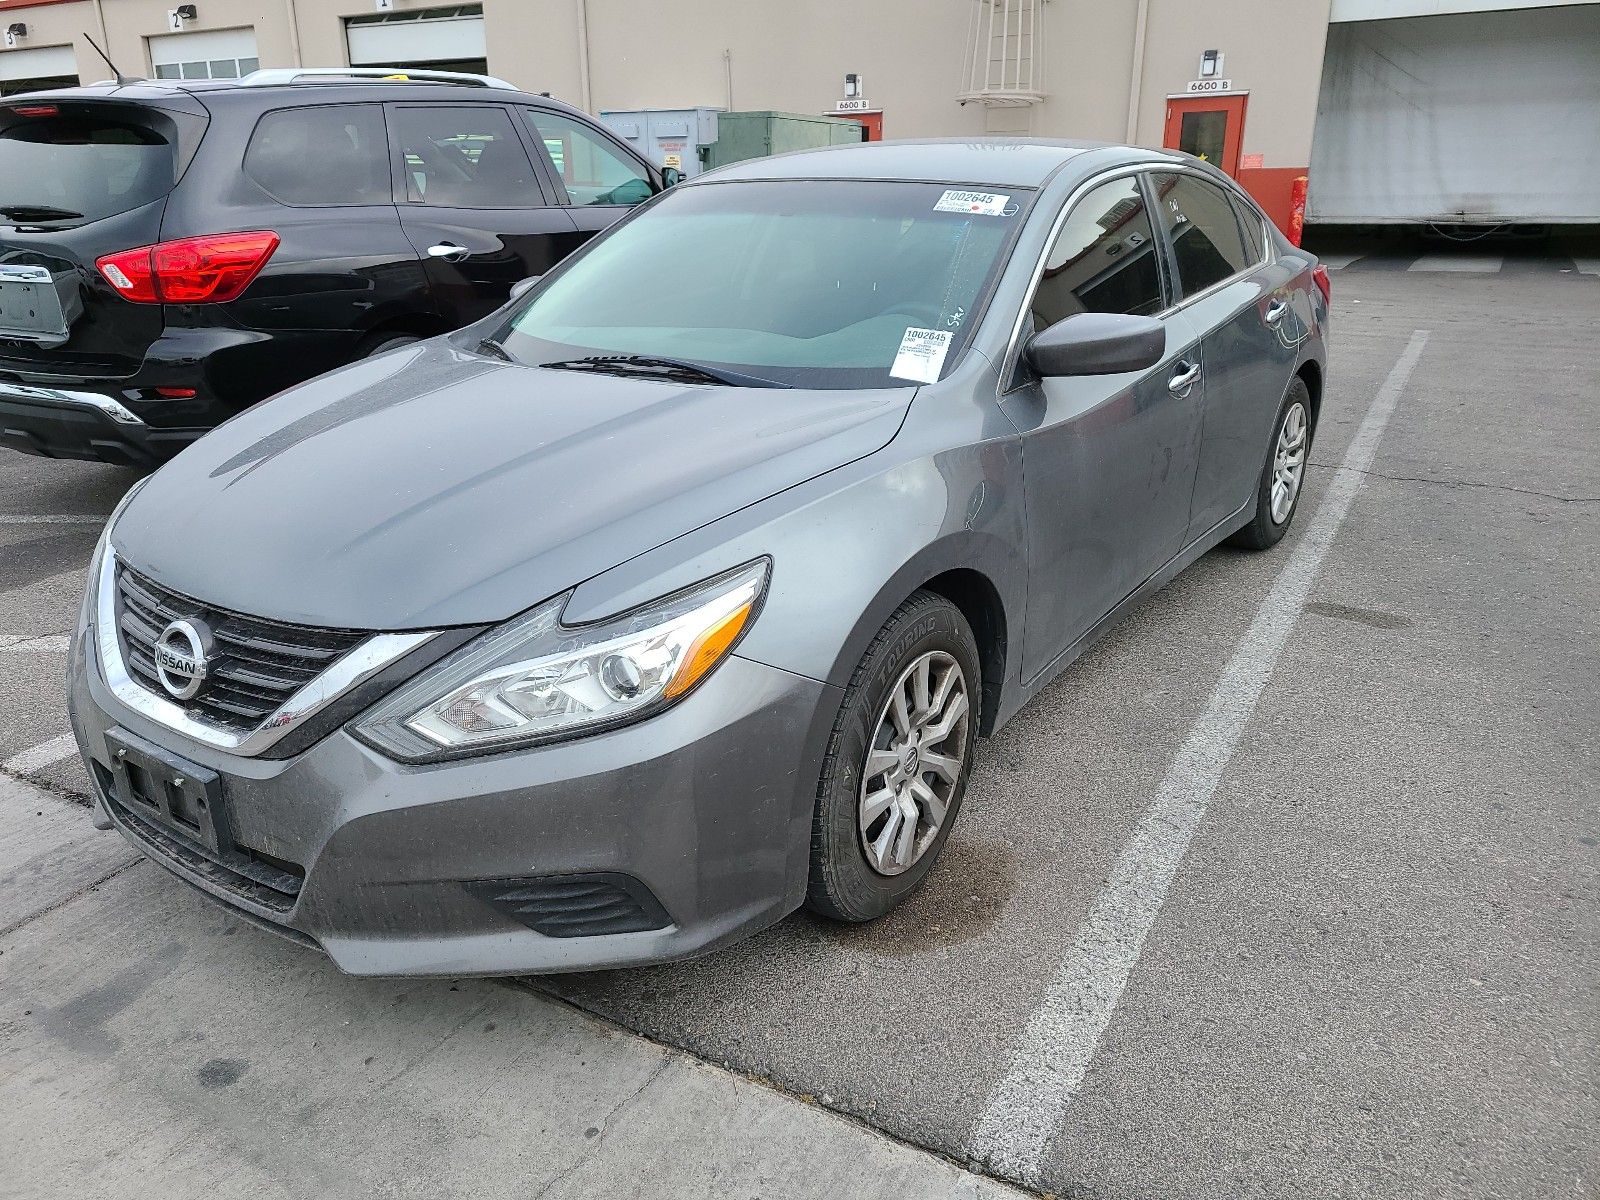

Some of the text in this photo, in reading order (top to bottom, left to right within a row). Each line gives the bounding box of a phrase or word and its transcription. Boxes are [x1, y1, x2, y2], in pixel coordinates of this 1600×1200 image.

[172, 13, 180, 28] 2
[1191, 81, 1228, 91] 6600 B
[839, 101, 859, 109] 6600
[944, 192, 996, 204] 1002645
[907, 330, 946, 342] 1002645
[156, 650, 196, 675] NISSAN
